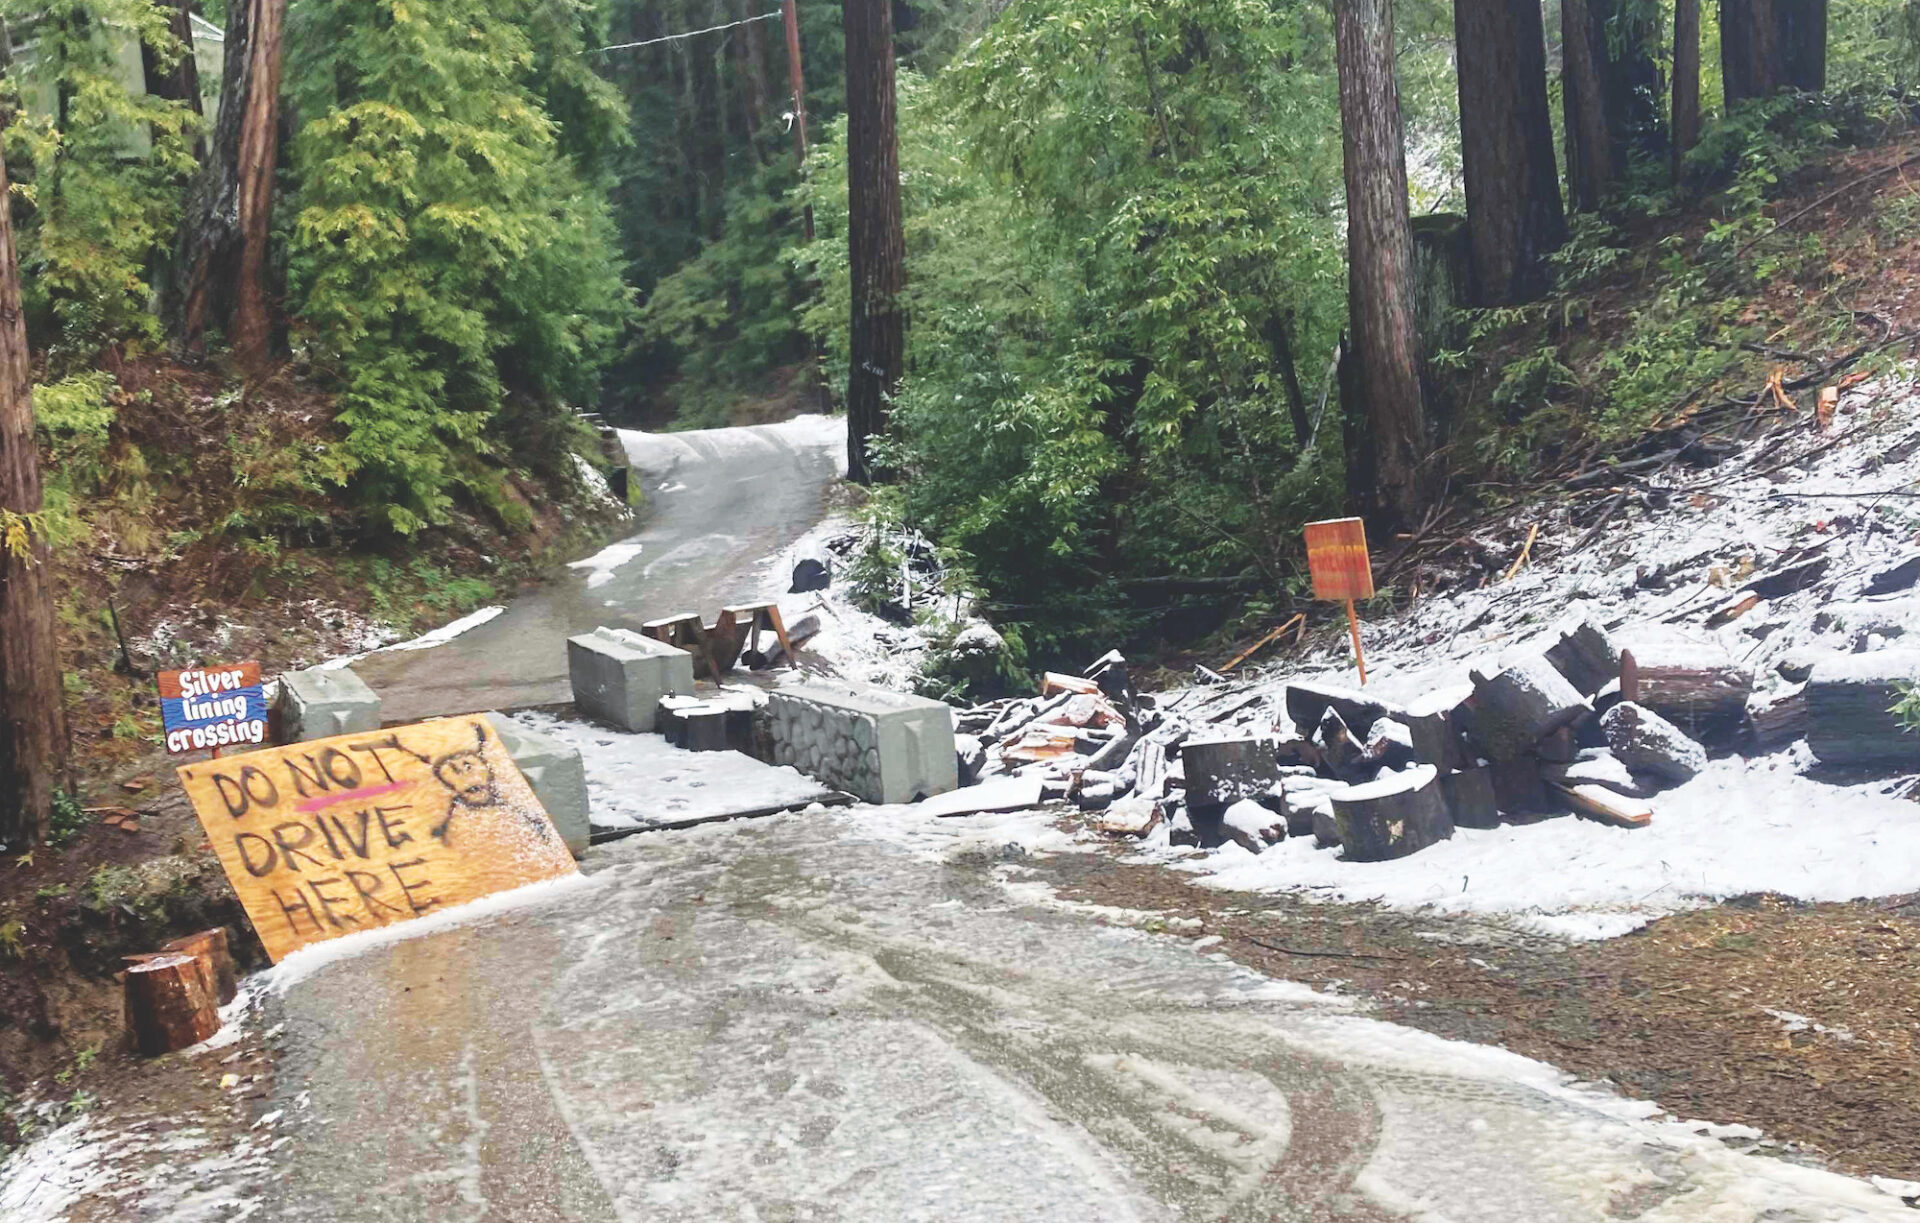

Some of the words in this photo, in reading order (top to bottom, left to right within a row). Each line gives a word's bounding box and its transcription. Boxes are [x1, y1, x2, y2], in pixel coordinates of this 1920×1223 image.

[179, 670, 244, 698] Silver
[182, 693, 247, 720] lining
[167, 719, 264, 752] crossing
[212, 765, 279, 819] DO
[282, 734, 399, 798] NOT
[235, 805, 414, 878] DRIVE
[271, 858, 441, 935] HERE
